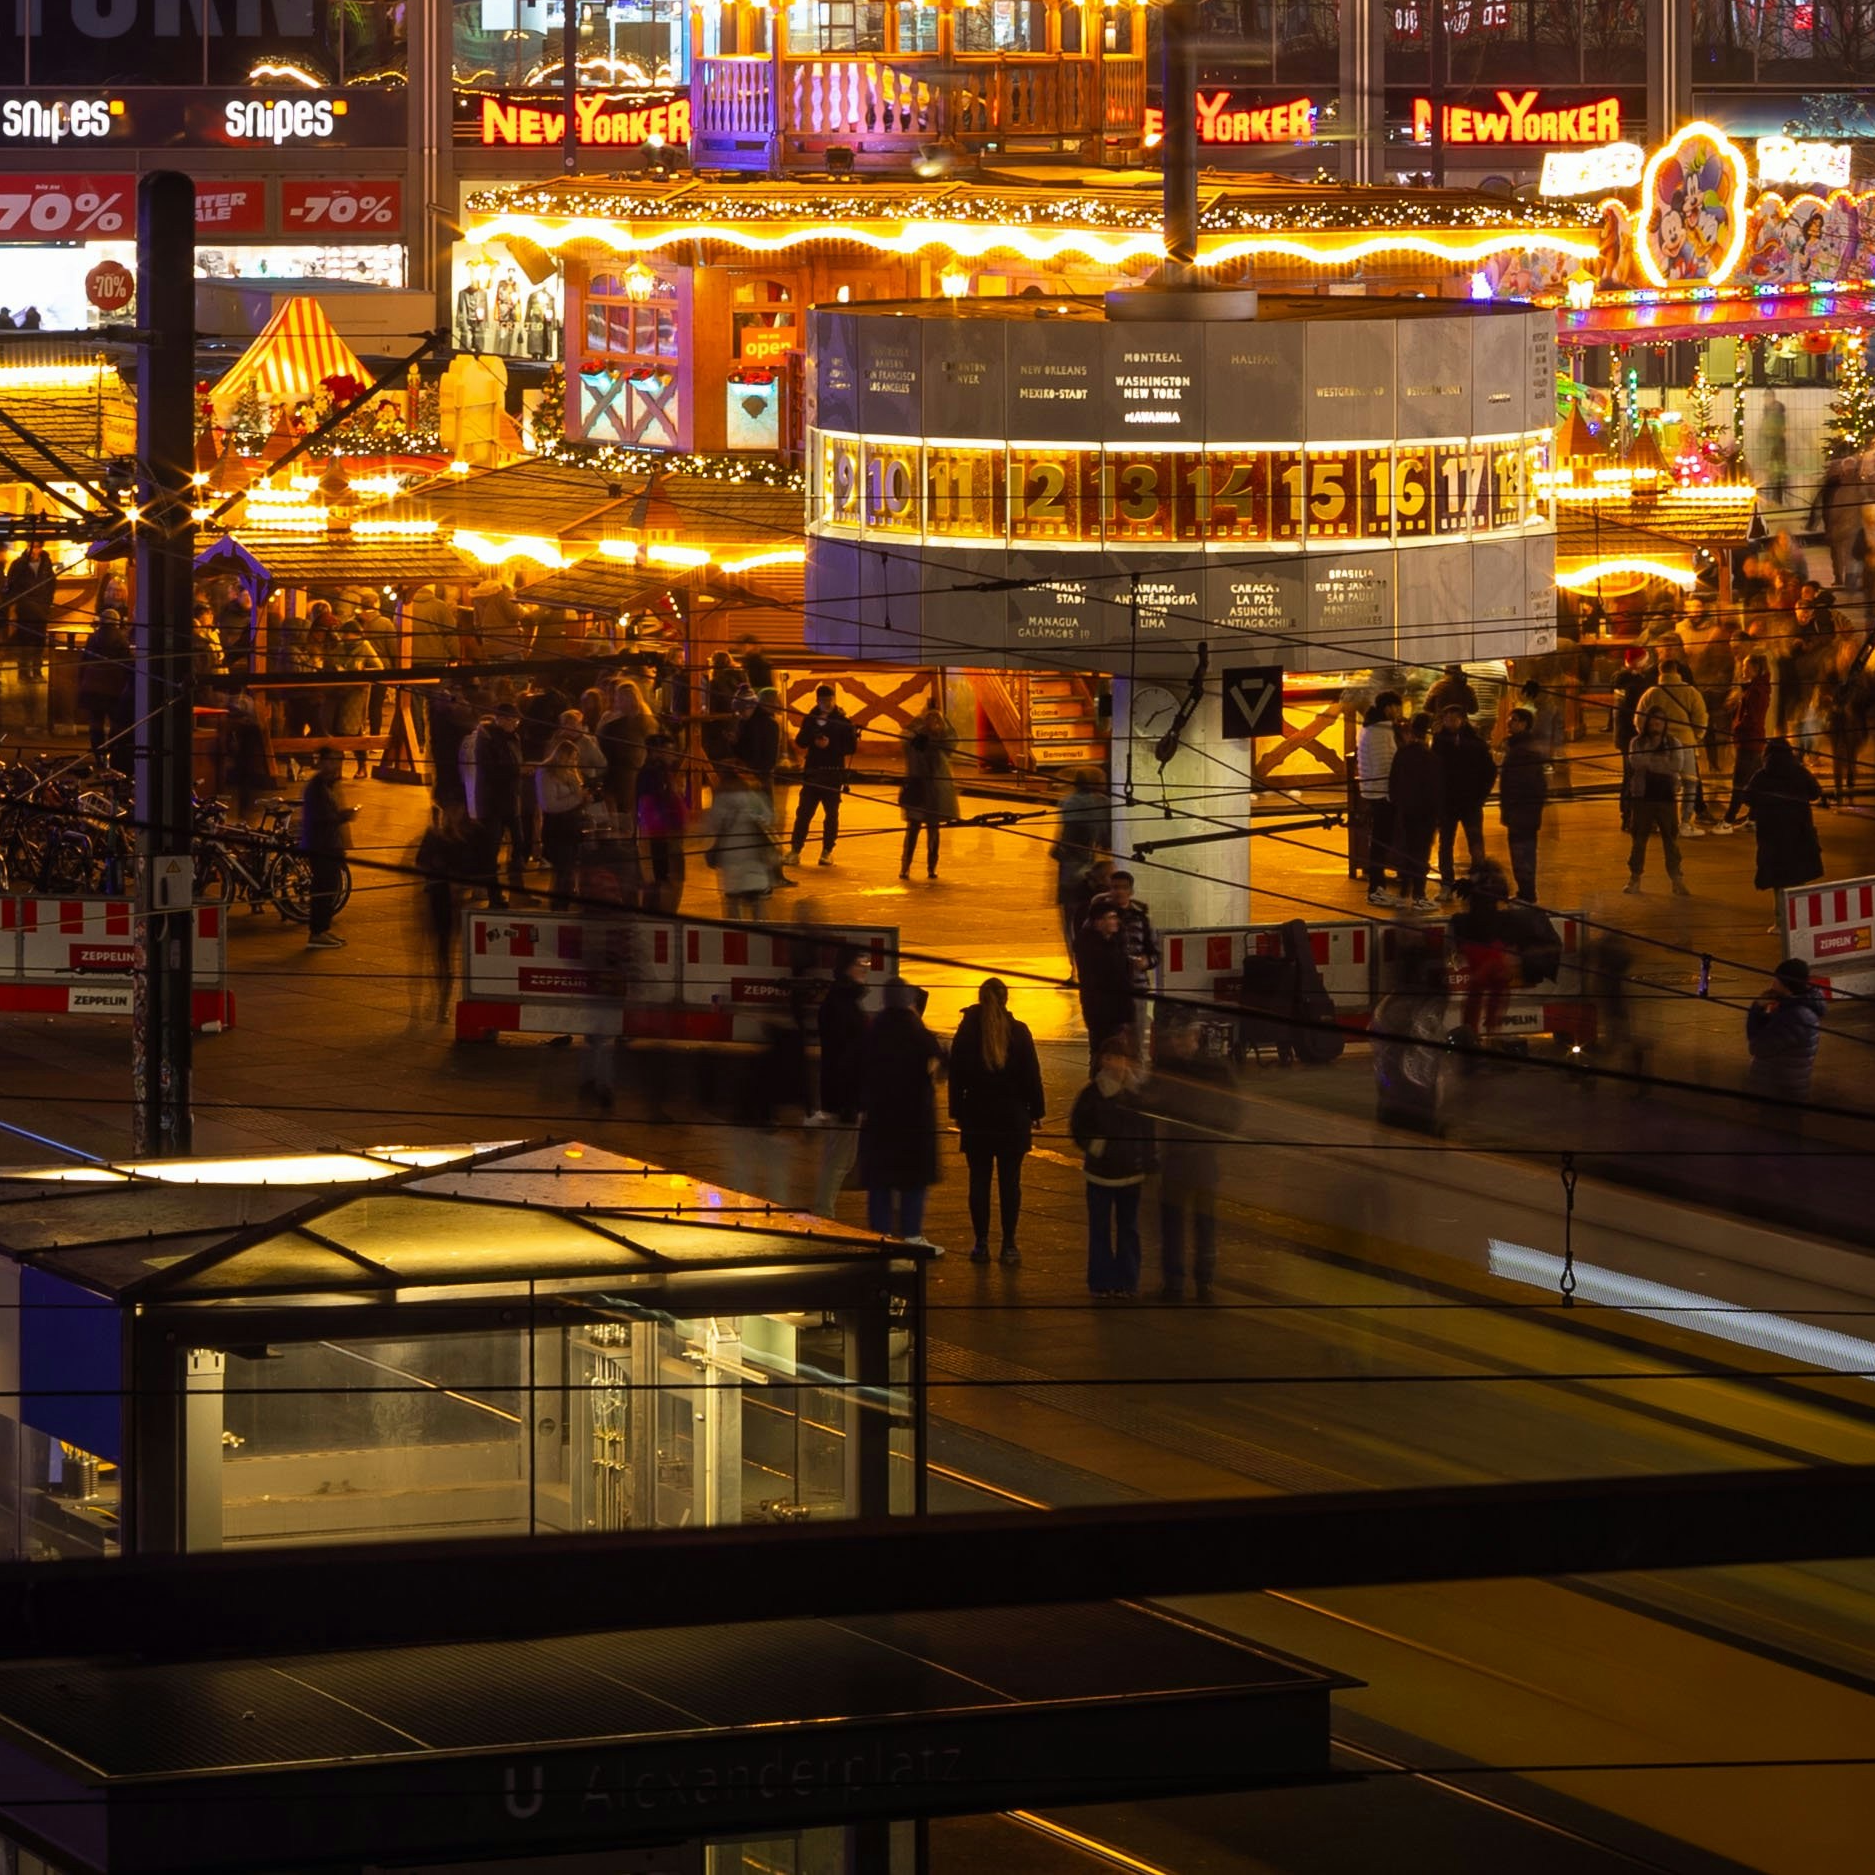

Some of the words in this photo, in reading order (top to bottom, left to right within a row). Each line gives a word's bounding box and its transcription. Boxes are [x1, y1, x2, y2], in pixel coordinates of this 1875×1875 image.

[2, 99, 111, 144] snipes
[225, 99, 334, 145] snipes
[289, 196, 392, 224] -70%
[91, 275, 127, 298] -70%
[745, 336, 795, 360] open
[1124, 352, 1182, 363] MONTREAL
[879, 370, 916, 381] FRANCISCO
[1020, 365, 1041, 375] NEW
[1044, 365, 1087, 375] ORLEANS
[869, 382, 881, 393] LOS
[882, 383, 910, 393] ANGELES
[1115, 376, 1190, 387] WASHINGTON
[1019, 388, 1088, 399] MEXIKO-STADT
[1124, 388, 1149, 399] NEW
[1153, 388, 1182, 399] YORK
[837, 456, 857, 514] 9
[866, 457, 911, 515] 10
[930, 463, 974, 520] 11
[1009, 463, 1067, 520] 12
[1092, 463, 1158, 520] 13
[1189, 464, 1255, 520] 14
[1284, 463, 1345, 520] 15
[1369, 459, 1425, 517] 16
[1441, 456, 1483, 514] 17
[1329, 569, 1374, 580] BRASILIA
[1236, 595, 1251, 605] LA
[1254, 595, 1274, 606] PAZ
[1326, 591, 1345, 604] SÃO
[1230, 603, 1282, 617] ASUNCIÓN
[1028, 616, 1079, 627] MANAGUA
[1140, 618, 1166, 629] LIMA
[1018, 626, 1074, 638] GALÁPAGOS
[1035, 728, 1068, 739] Eingang
[80, 950, 135, 963] ZEPPELIN
[530, 974, 588, 988] ZEPPELIN
[73, 994, 128, 1008] ZEPPELIN
[502, 1766, 543, 1820] U
[581, 1741, 962, 1814] Alexanderplatz
